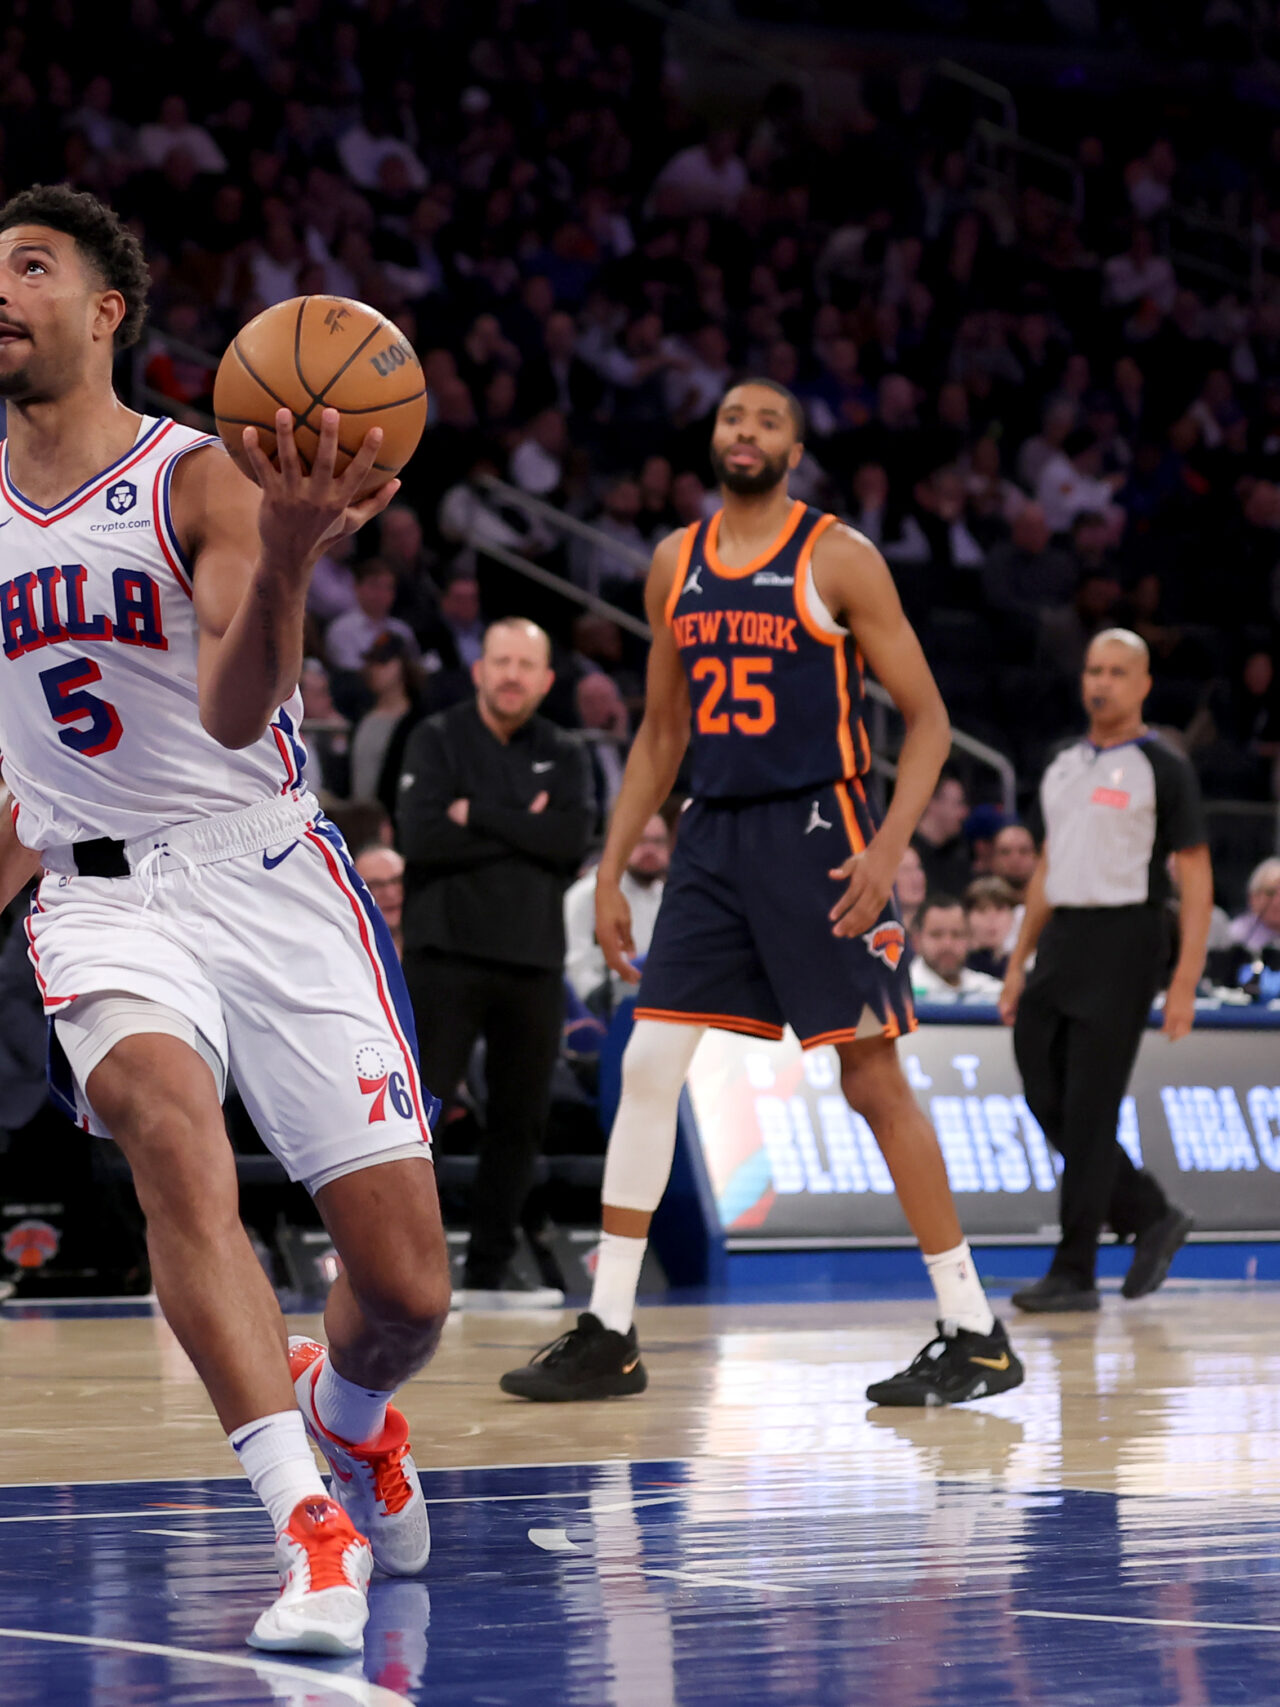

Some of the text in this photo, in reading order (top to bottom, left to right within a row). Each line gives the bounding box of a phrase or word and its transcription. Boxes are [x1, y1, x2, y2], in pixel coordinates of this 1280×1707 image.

[89, 519, 151, 532] crypto.com
[673, 610, 798, 652] NEW YORK
[38, 657, 124, 758] 5
[692, 657, 776, 735] 25
[357, 1071, 413, 1125] 76
